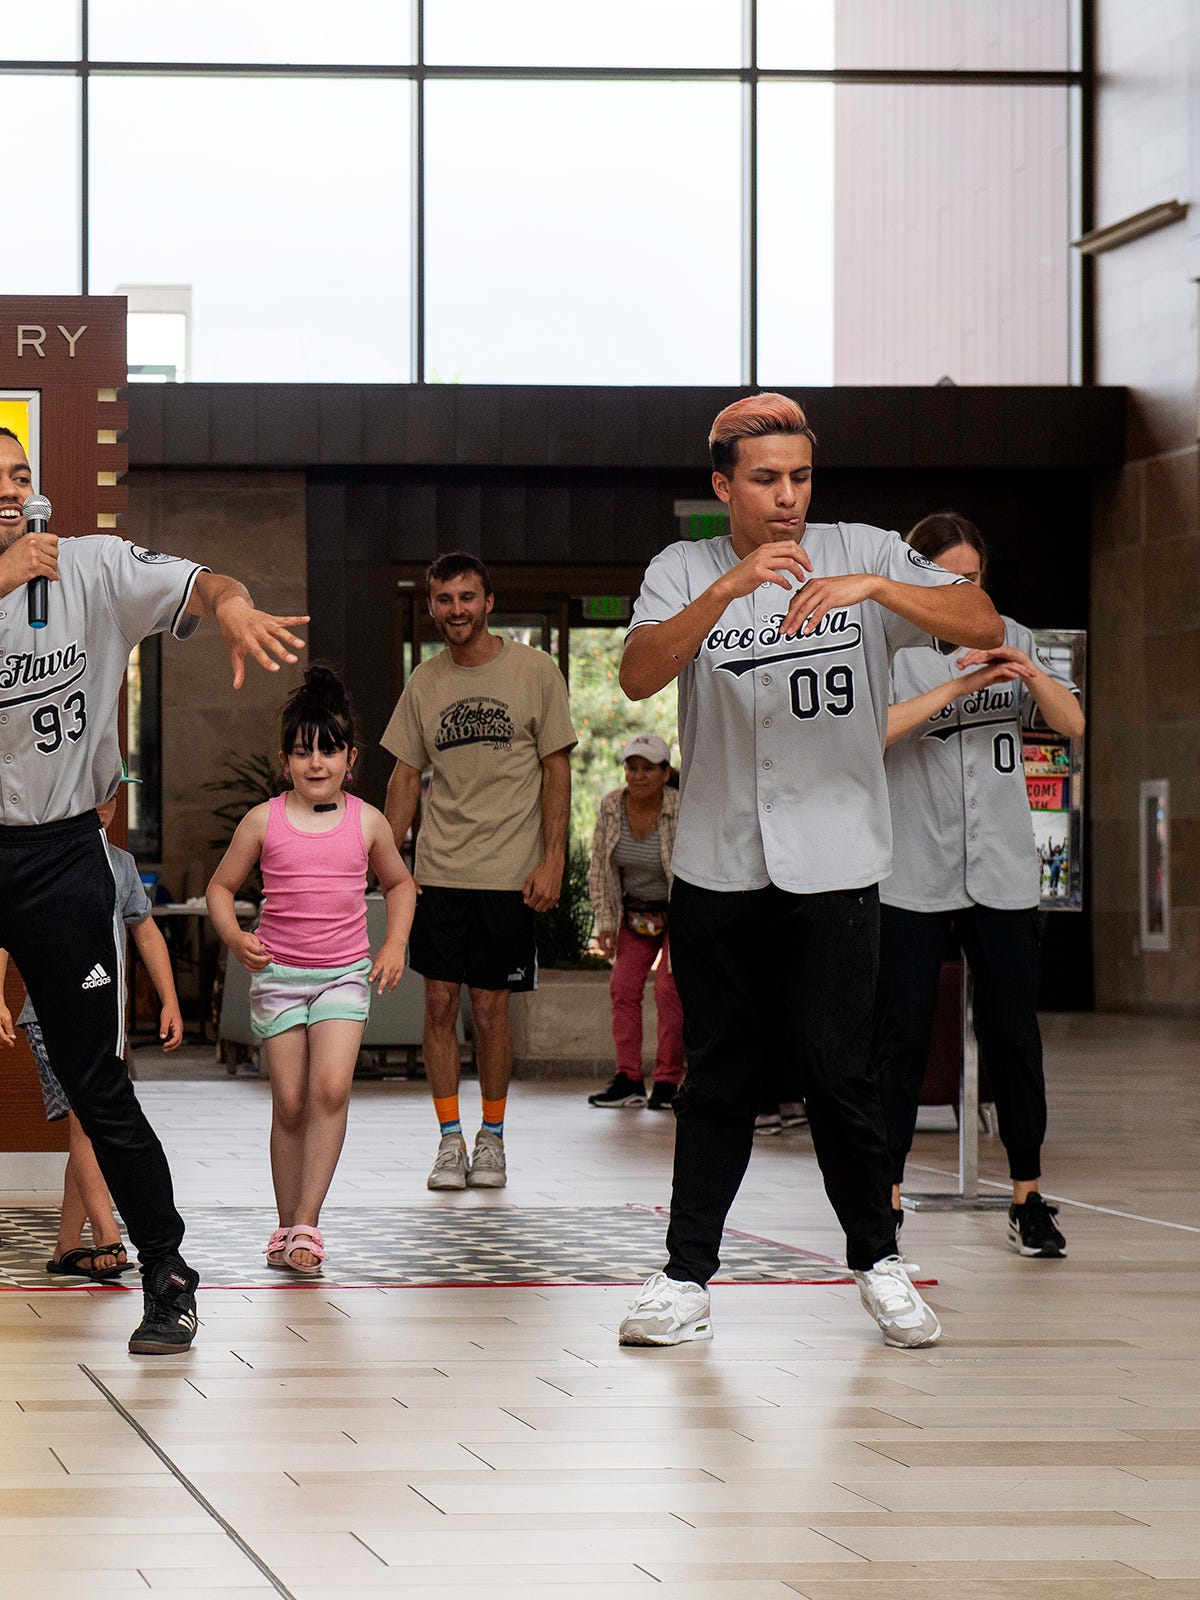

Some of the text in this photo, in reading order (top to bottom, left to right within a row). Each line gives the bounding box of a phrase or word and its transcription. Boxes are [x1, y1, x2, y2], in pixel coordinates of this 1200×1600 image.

[591, 595, 622, 617] EXIT
[698, 626, 755, 656] oco
[788, 664, 855, 720] 09
[962, 687, 1013, 716] Flav
[30, 688, 87, 756] 93
[991, 731, 1023, 776] 0
[1026, 783, 1057, 797] COME
[82, 976, 111, 990] adidas
